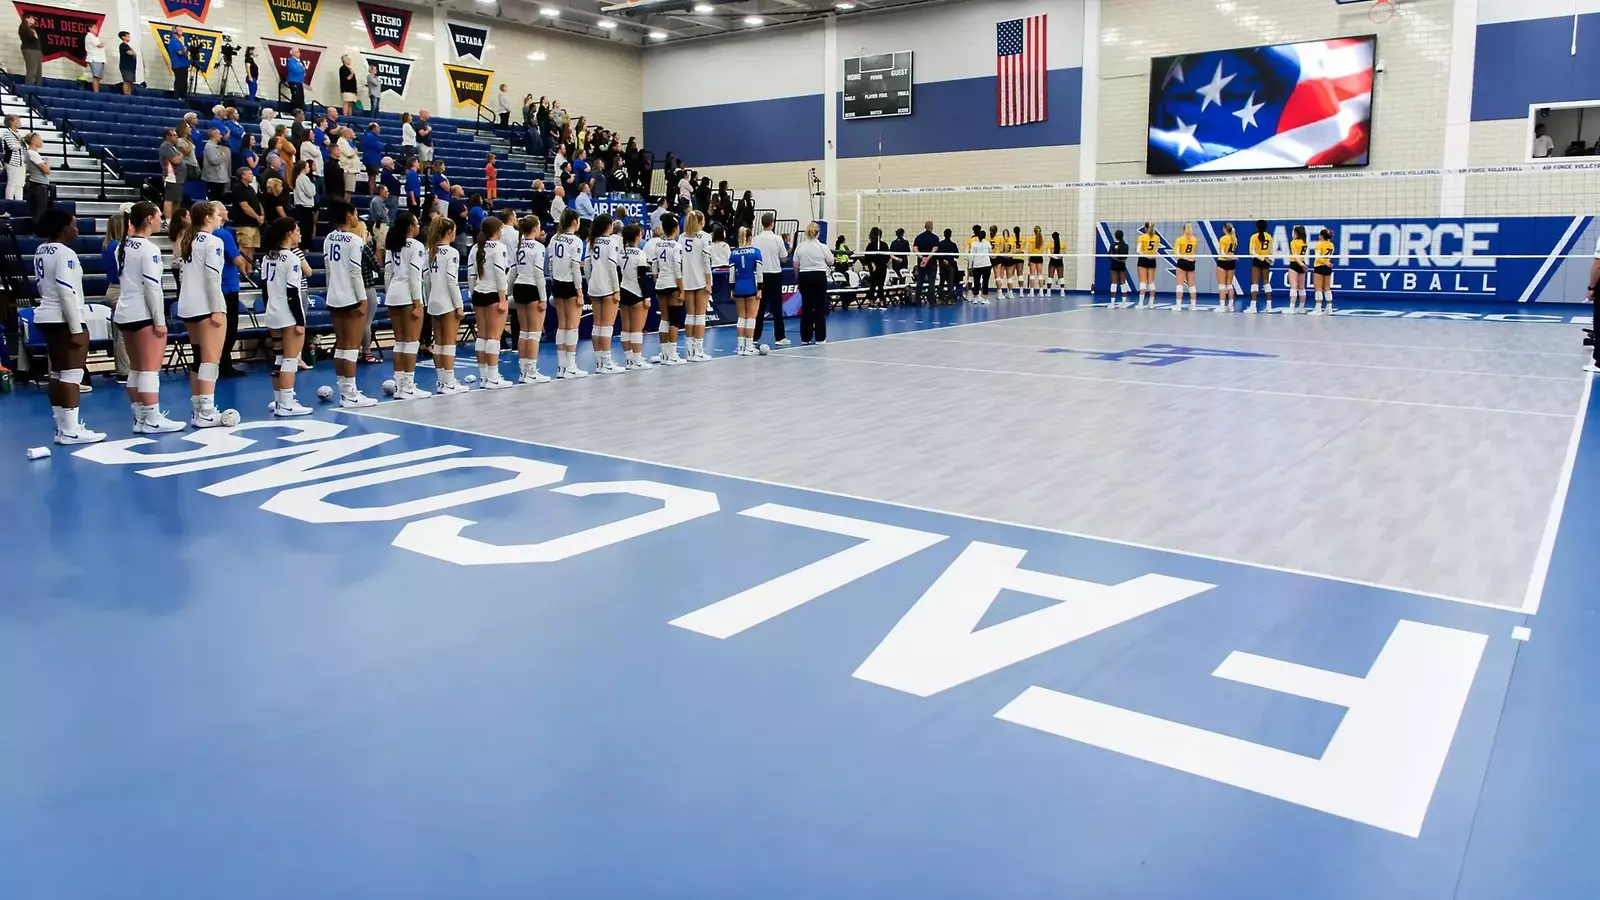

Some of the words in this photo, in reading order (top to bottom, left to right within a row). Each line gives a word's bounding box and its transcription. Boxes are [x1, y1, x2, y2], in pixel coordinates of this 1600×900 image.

[281, 11, 304, 23] STATE
[371, 14, 402, 27] FRESNO
[60, 20, 89, 34] DIEG
[375, 26, 400, 38] STATE
[47, 34, 78, 47] STATE
[455, 34, 482, 46] NEVADA
[280, 57, 310, 69] UV
[378, 64, 400, 75] UTAH
[890, 69, 908, 77] GUEST
[377, 76, 402, 87] STATE
[456, 80, 484, 92] WYOMING
[593, 202, 609, 217] AIR
[610, 202, 643, 217] FRCE
[554, 242, 564, 259] 10
[685, 238, 693, 253] 5
[1147, 241, 1155, 251] 5
[1185, 244, 1193, 253] 8
[1339, 223, 1500, 267] FORCE
[329, 243, 341, 261] 16
[593, 246, 600, 260] 9
[659, 249, 667, 262] 4
[621, 256, 630, 270] 7
[741, 255, 746, 269] 1
[266, 262, 277, 281] 17
[71, 418, 1489, 839] FALCONS
